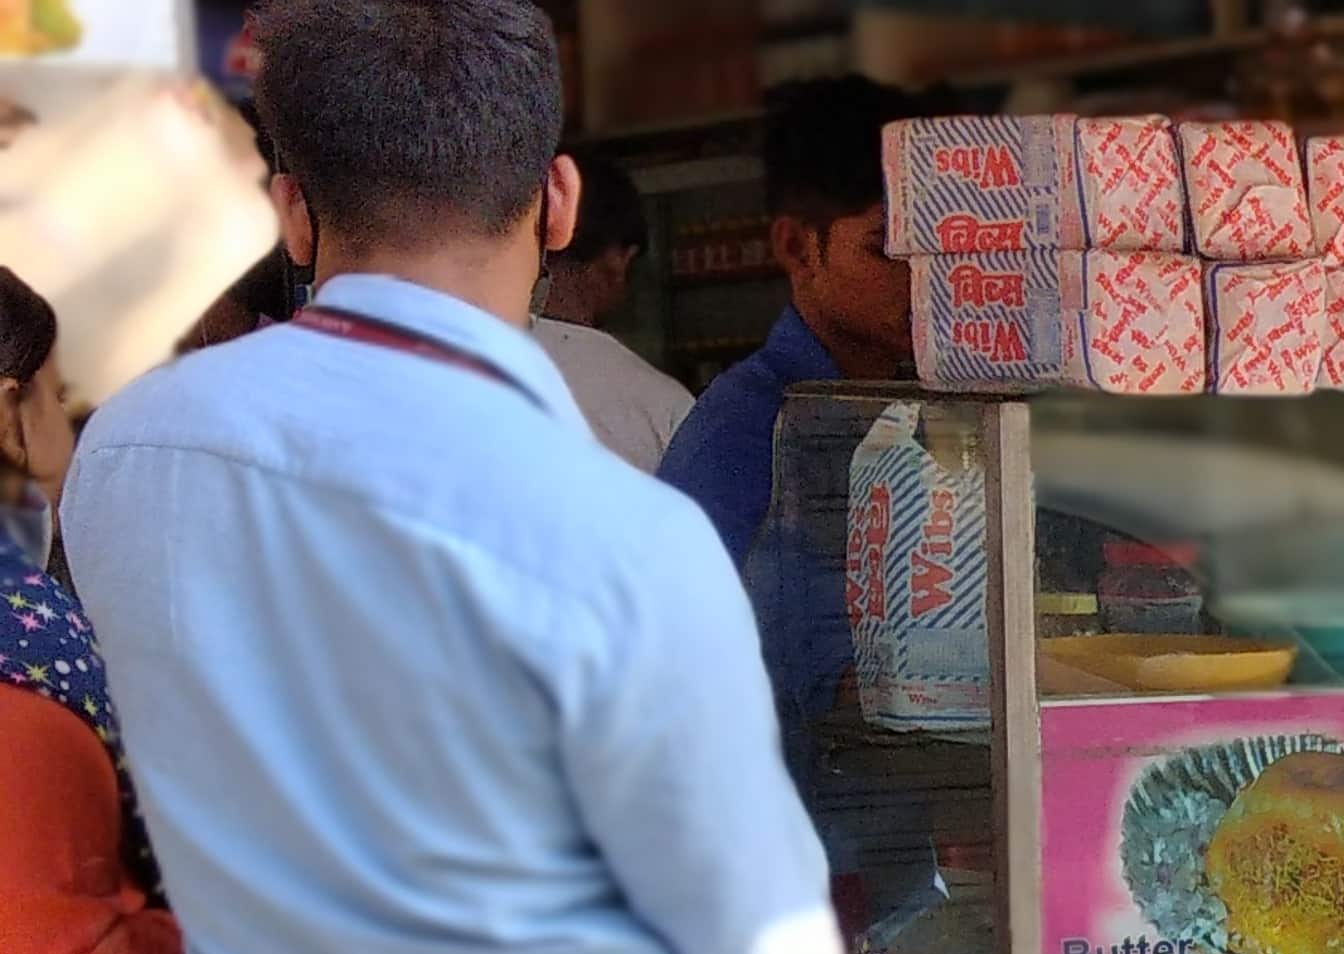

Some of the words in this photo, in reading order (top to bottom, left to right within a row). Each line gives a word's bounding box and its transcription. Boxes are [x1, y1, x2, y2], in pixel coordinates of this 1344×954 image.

[936, 146, 1020, 189] Wibs
[953, 321, 1027, 362] Wibs
[911, 489, 955, 619] Wibs
